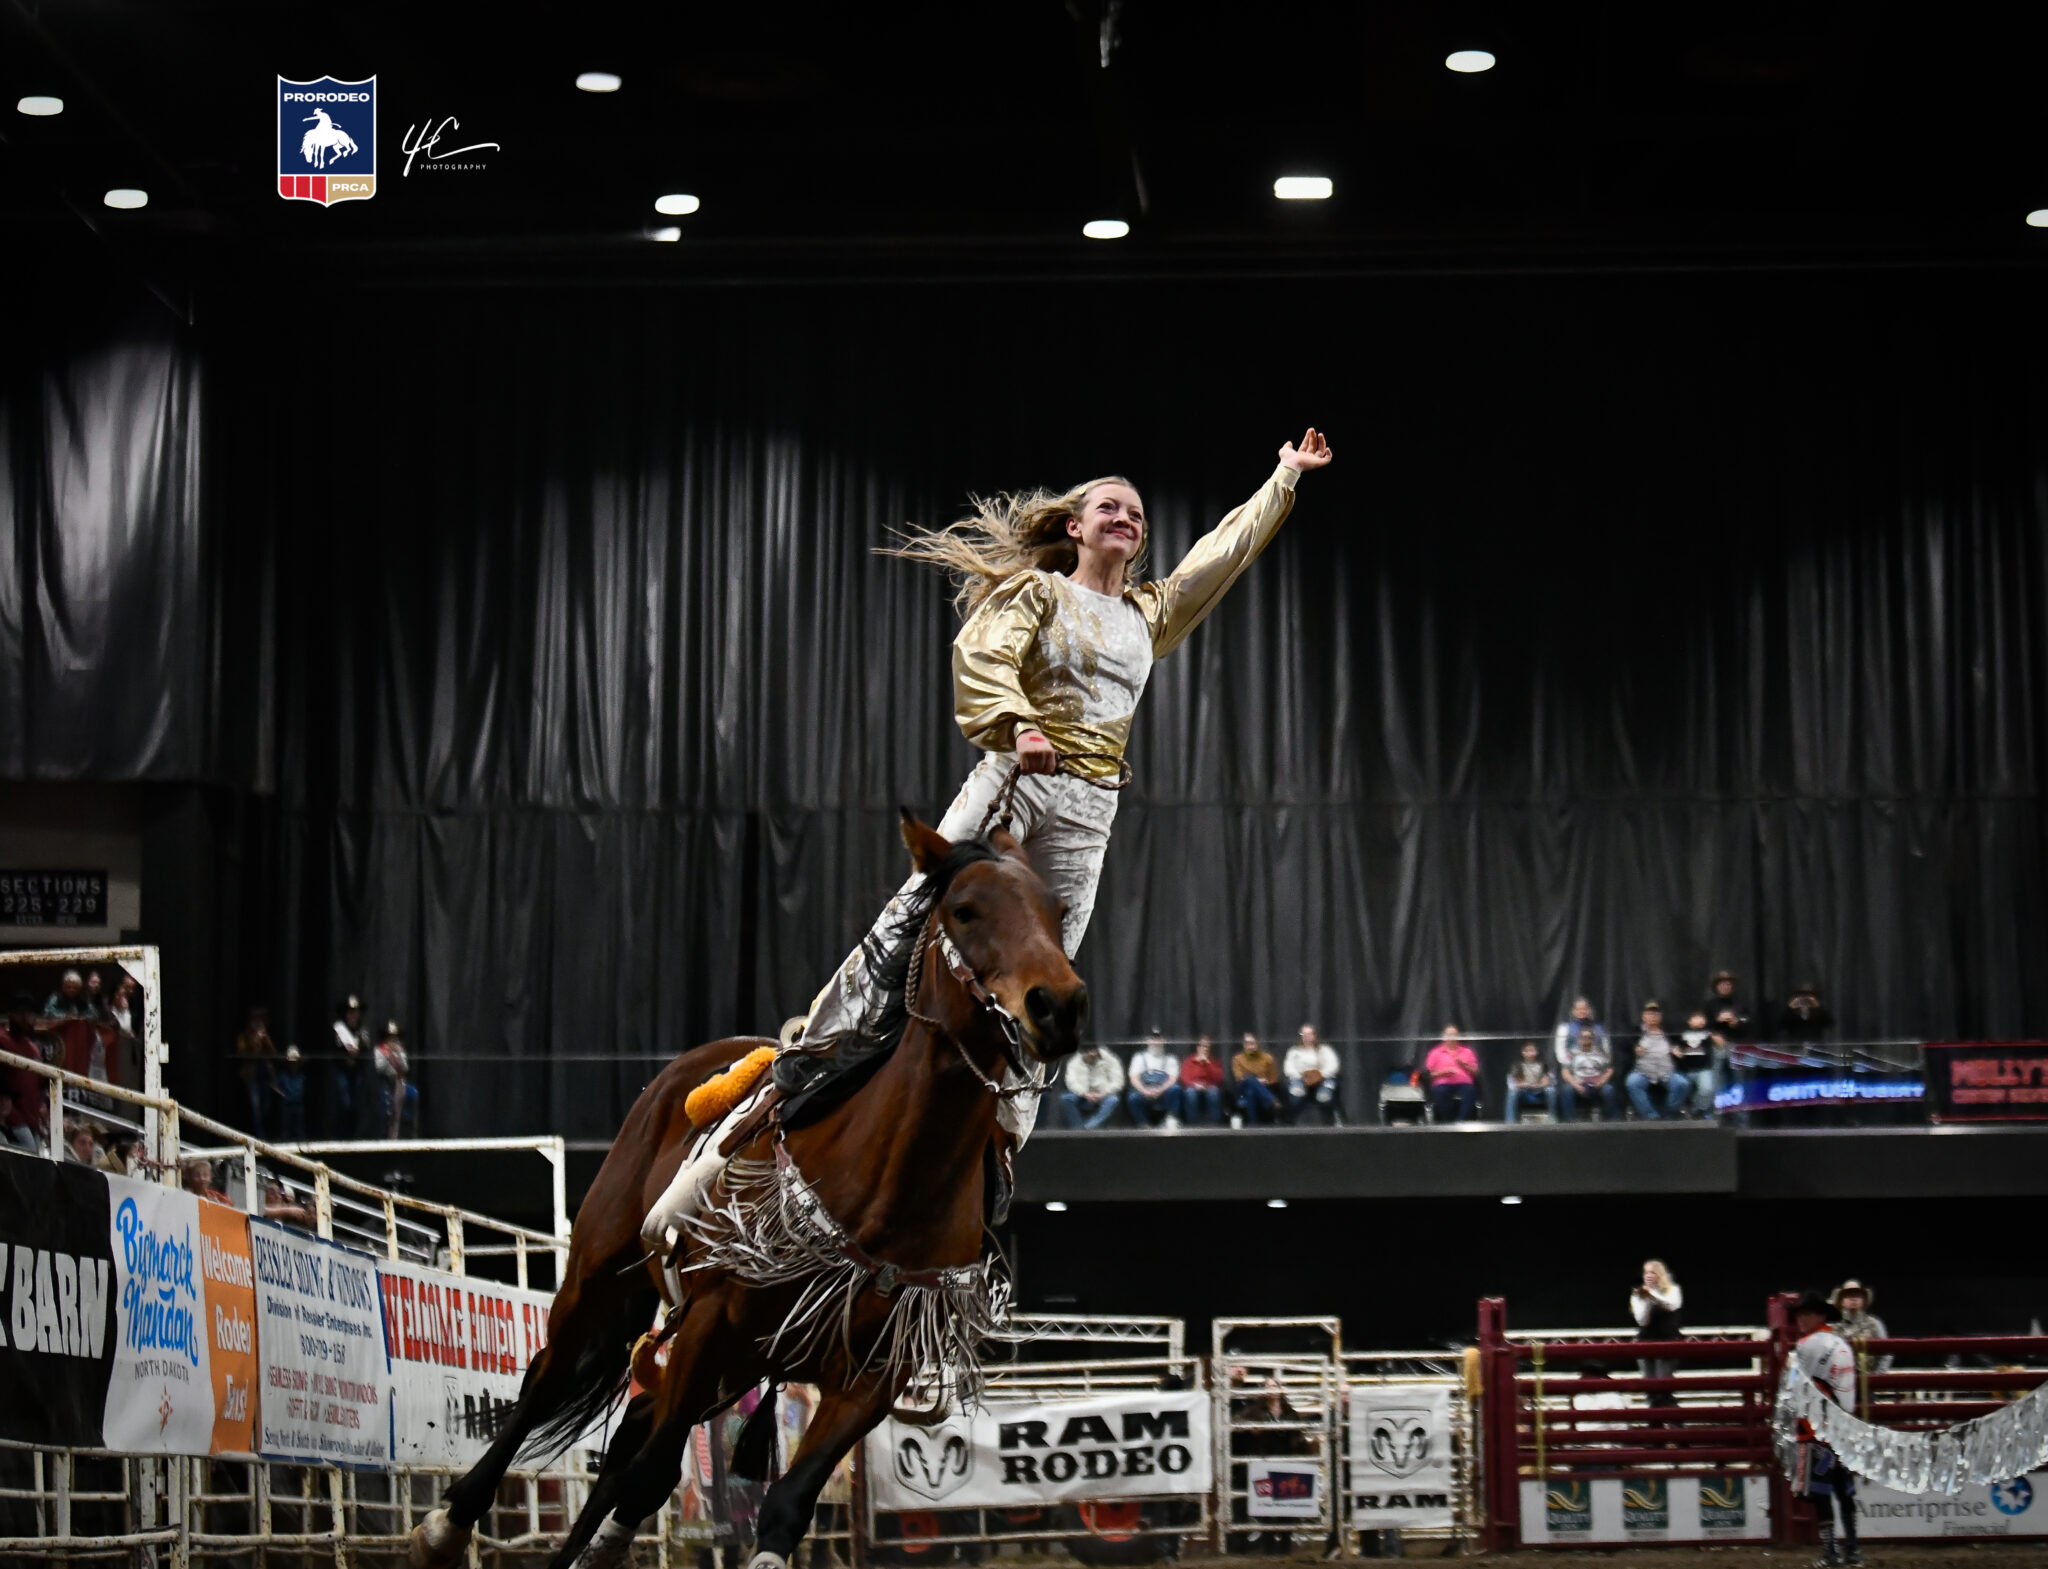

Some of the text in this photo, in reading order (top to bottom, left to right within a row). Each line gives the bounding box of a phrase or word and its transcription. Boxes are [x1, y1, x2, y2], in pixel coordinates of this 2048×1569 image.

[0, 877, 101, 895] SECTIONS
[116, 1197, 196, 1301] Bismarck
[200, 1232, 254, 1291] Welcome
[255, 1234, 294, 1290] RESSLER
[124, 1279, 199, 1368] Mandan
[267, 1296, 293, 1320] Division
[379, 1273, 466, 1368] WELCOME
[468, 1292, 517, 1376] RODEO
[216, 1303, 252, 1356] Rodeo
[134, 1360, 190, 1385] NORTH DAKOTA
[999, 1409, 1190, 1449] RAM
[1001, 1444, 1193, 1485] RODEO
[1355, 1494, 1448, 1510] RAM
[1856, 1497, 1987, 1523] Ameriprise
